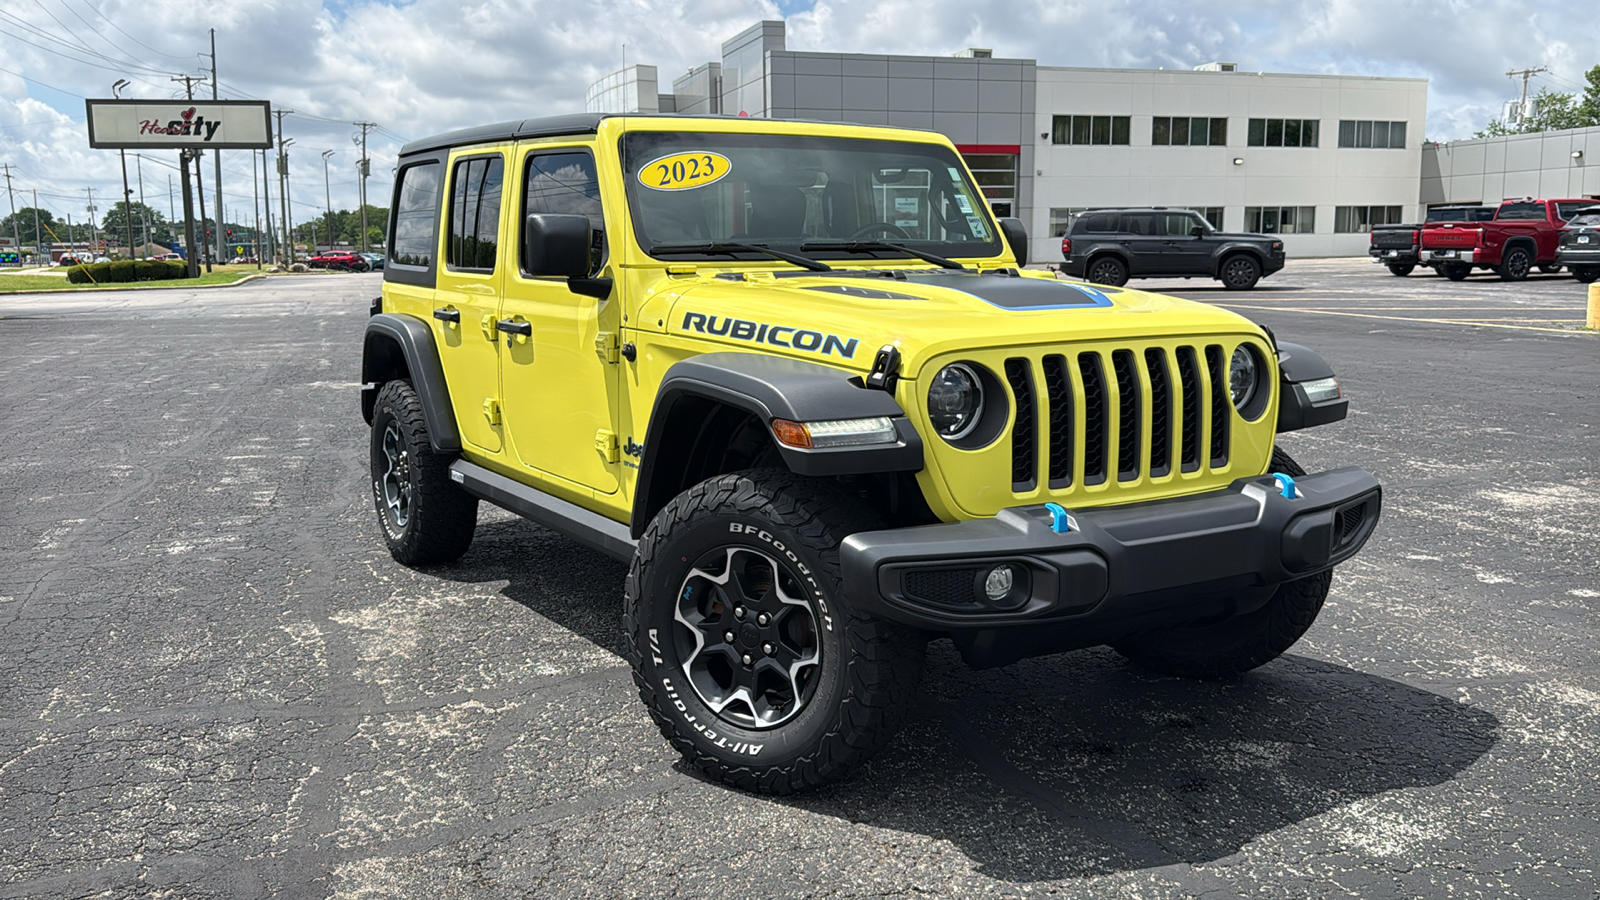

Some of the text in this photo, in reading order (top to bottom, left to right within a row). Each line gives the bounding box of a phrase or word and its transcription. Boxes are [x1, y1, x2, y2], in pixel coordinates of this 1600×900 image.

[139, 119, 196, 135] Heart
[657, 155, 715, 186] 2023
[681, 311, 860, 359] RUBICON
[623, 436, 644, 457] Jee
[729, 522, 833, 631] BFGoodrich
[649, 628, 764, 756] All-Terrain T/A
